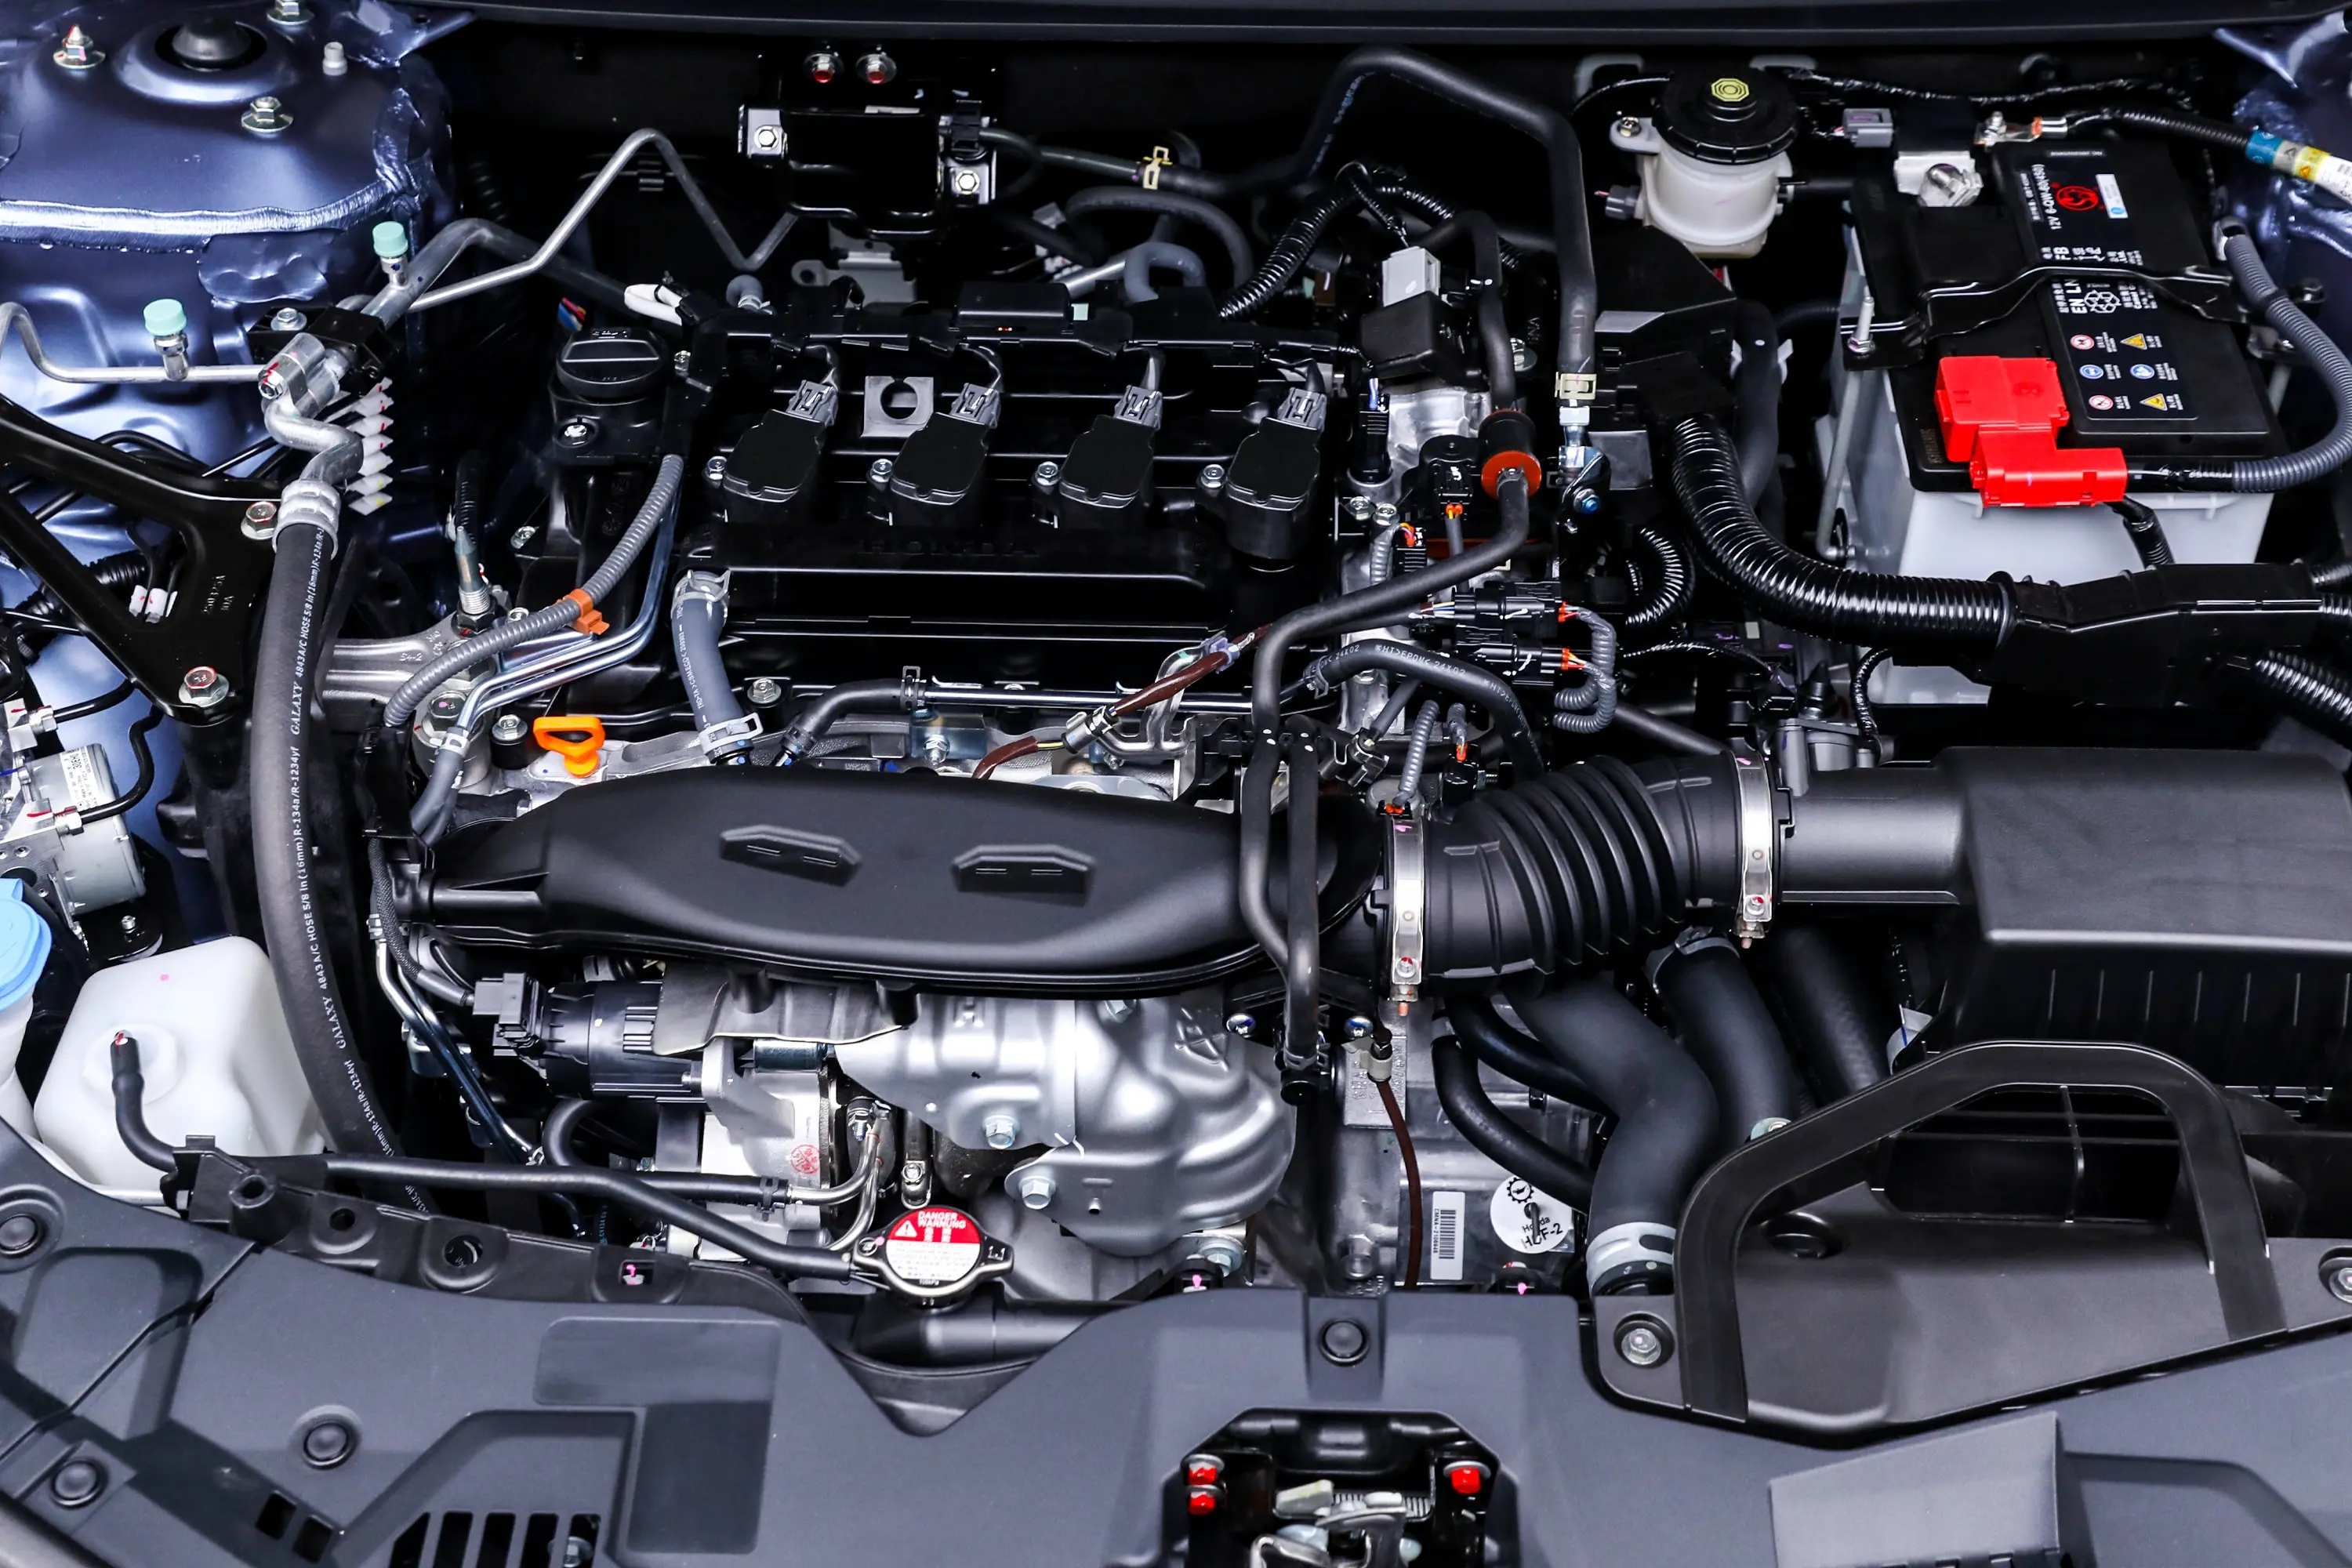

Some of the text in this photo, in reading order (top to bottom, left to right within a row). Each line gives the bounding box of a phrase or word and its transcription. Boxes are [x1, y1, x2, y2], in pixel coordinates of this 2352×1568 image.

[2047, 216, 2062, 230] 12V
[2068, 298, 2088, 314] EN
[303, 603, 313, 617] 5/8
[300, 615, 311, 639] HOSE
[290, 681, 303, 735] GALAXY
[301, 893, 311, 911] 5/8
[304, 912, 318, 942] HOSE
[322, 996, 347, 1049] GALAXY
[917, 1210, 959, 1221] DANGER
[1522, 1217, 1551, 1233] Hoda
[1525, 1223, 1563, 1247] HF-2
